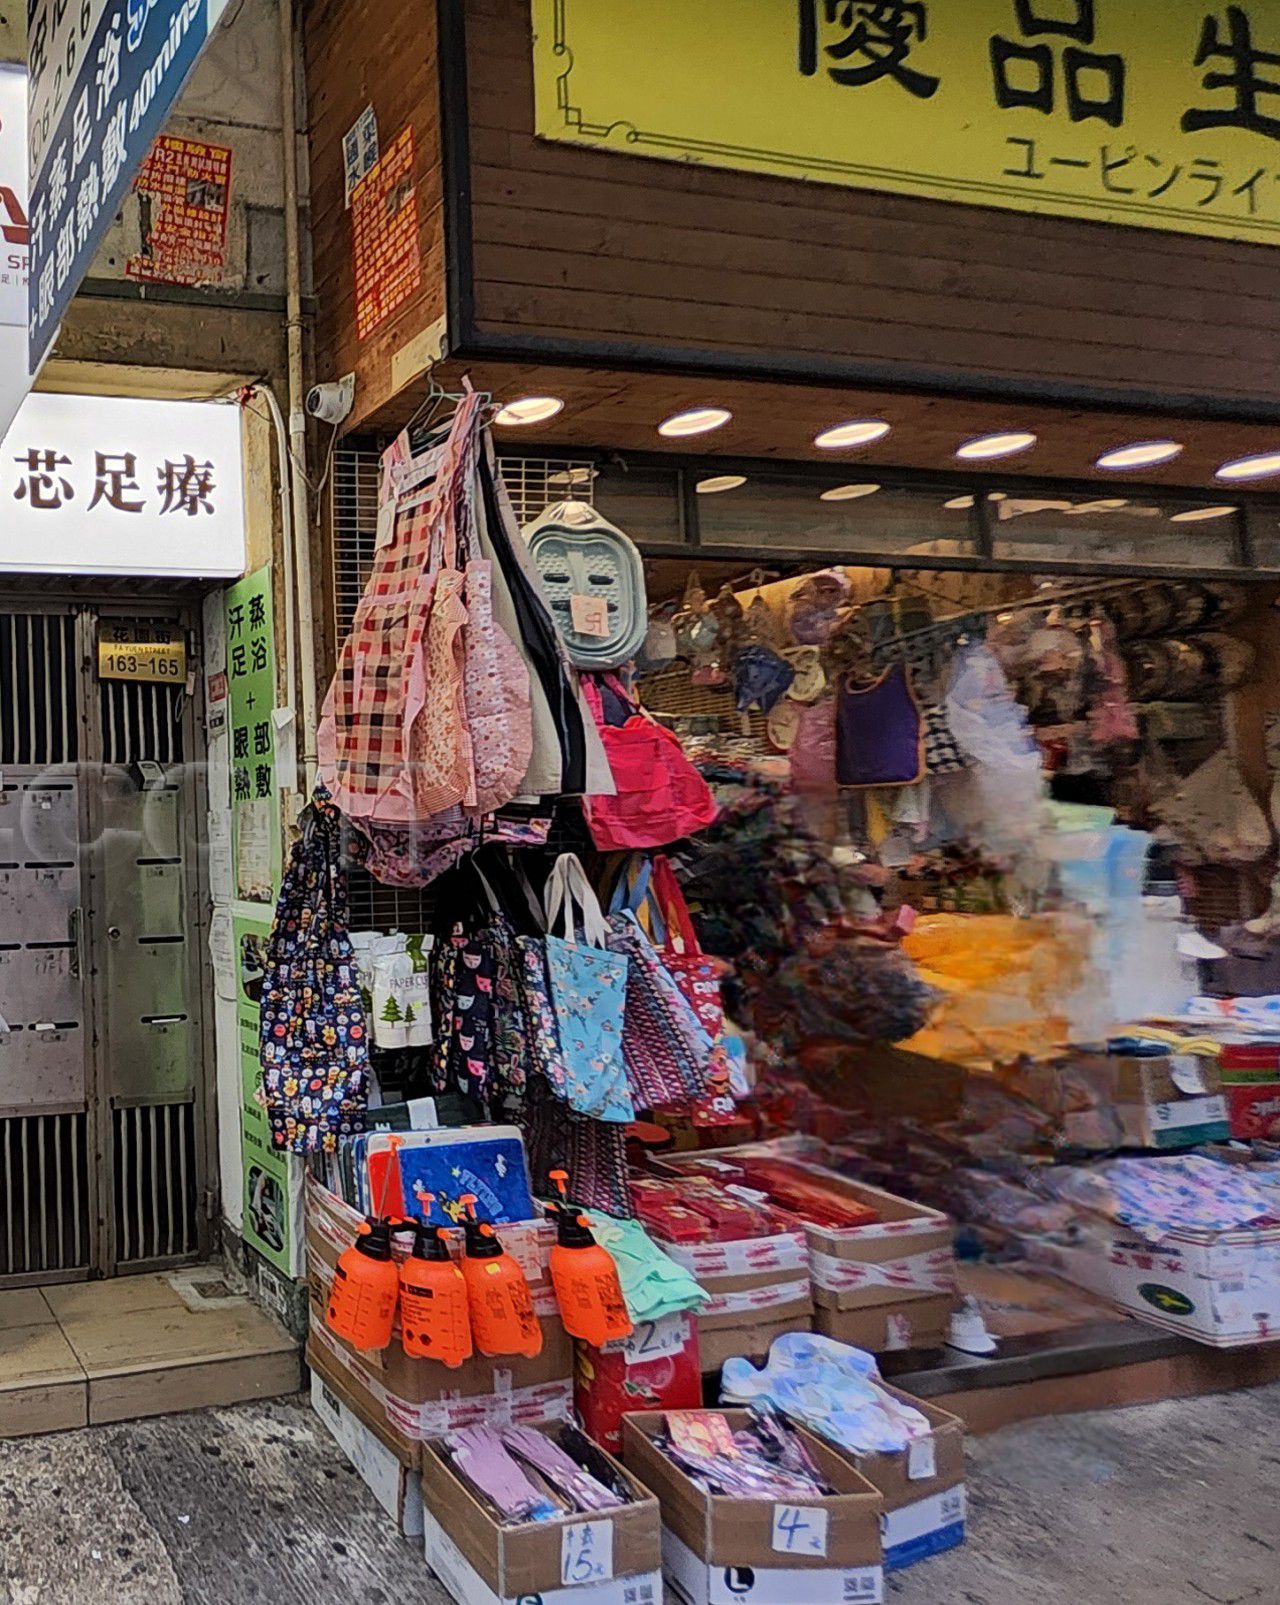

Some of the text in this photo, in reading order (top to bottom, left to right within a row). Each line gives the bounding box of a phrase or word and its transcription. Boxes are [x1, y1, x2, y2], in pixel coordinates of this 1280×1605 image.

[1003, 138, 1280, 213] ユーピンライ
[8, 255, 31, 271] SP
[107, 654, 179, 676] 163-165
